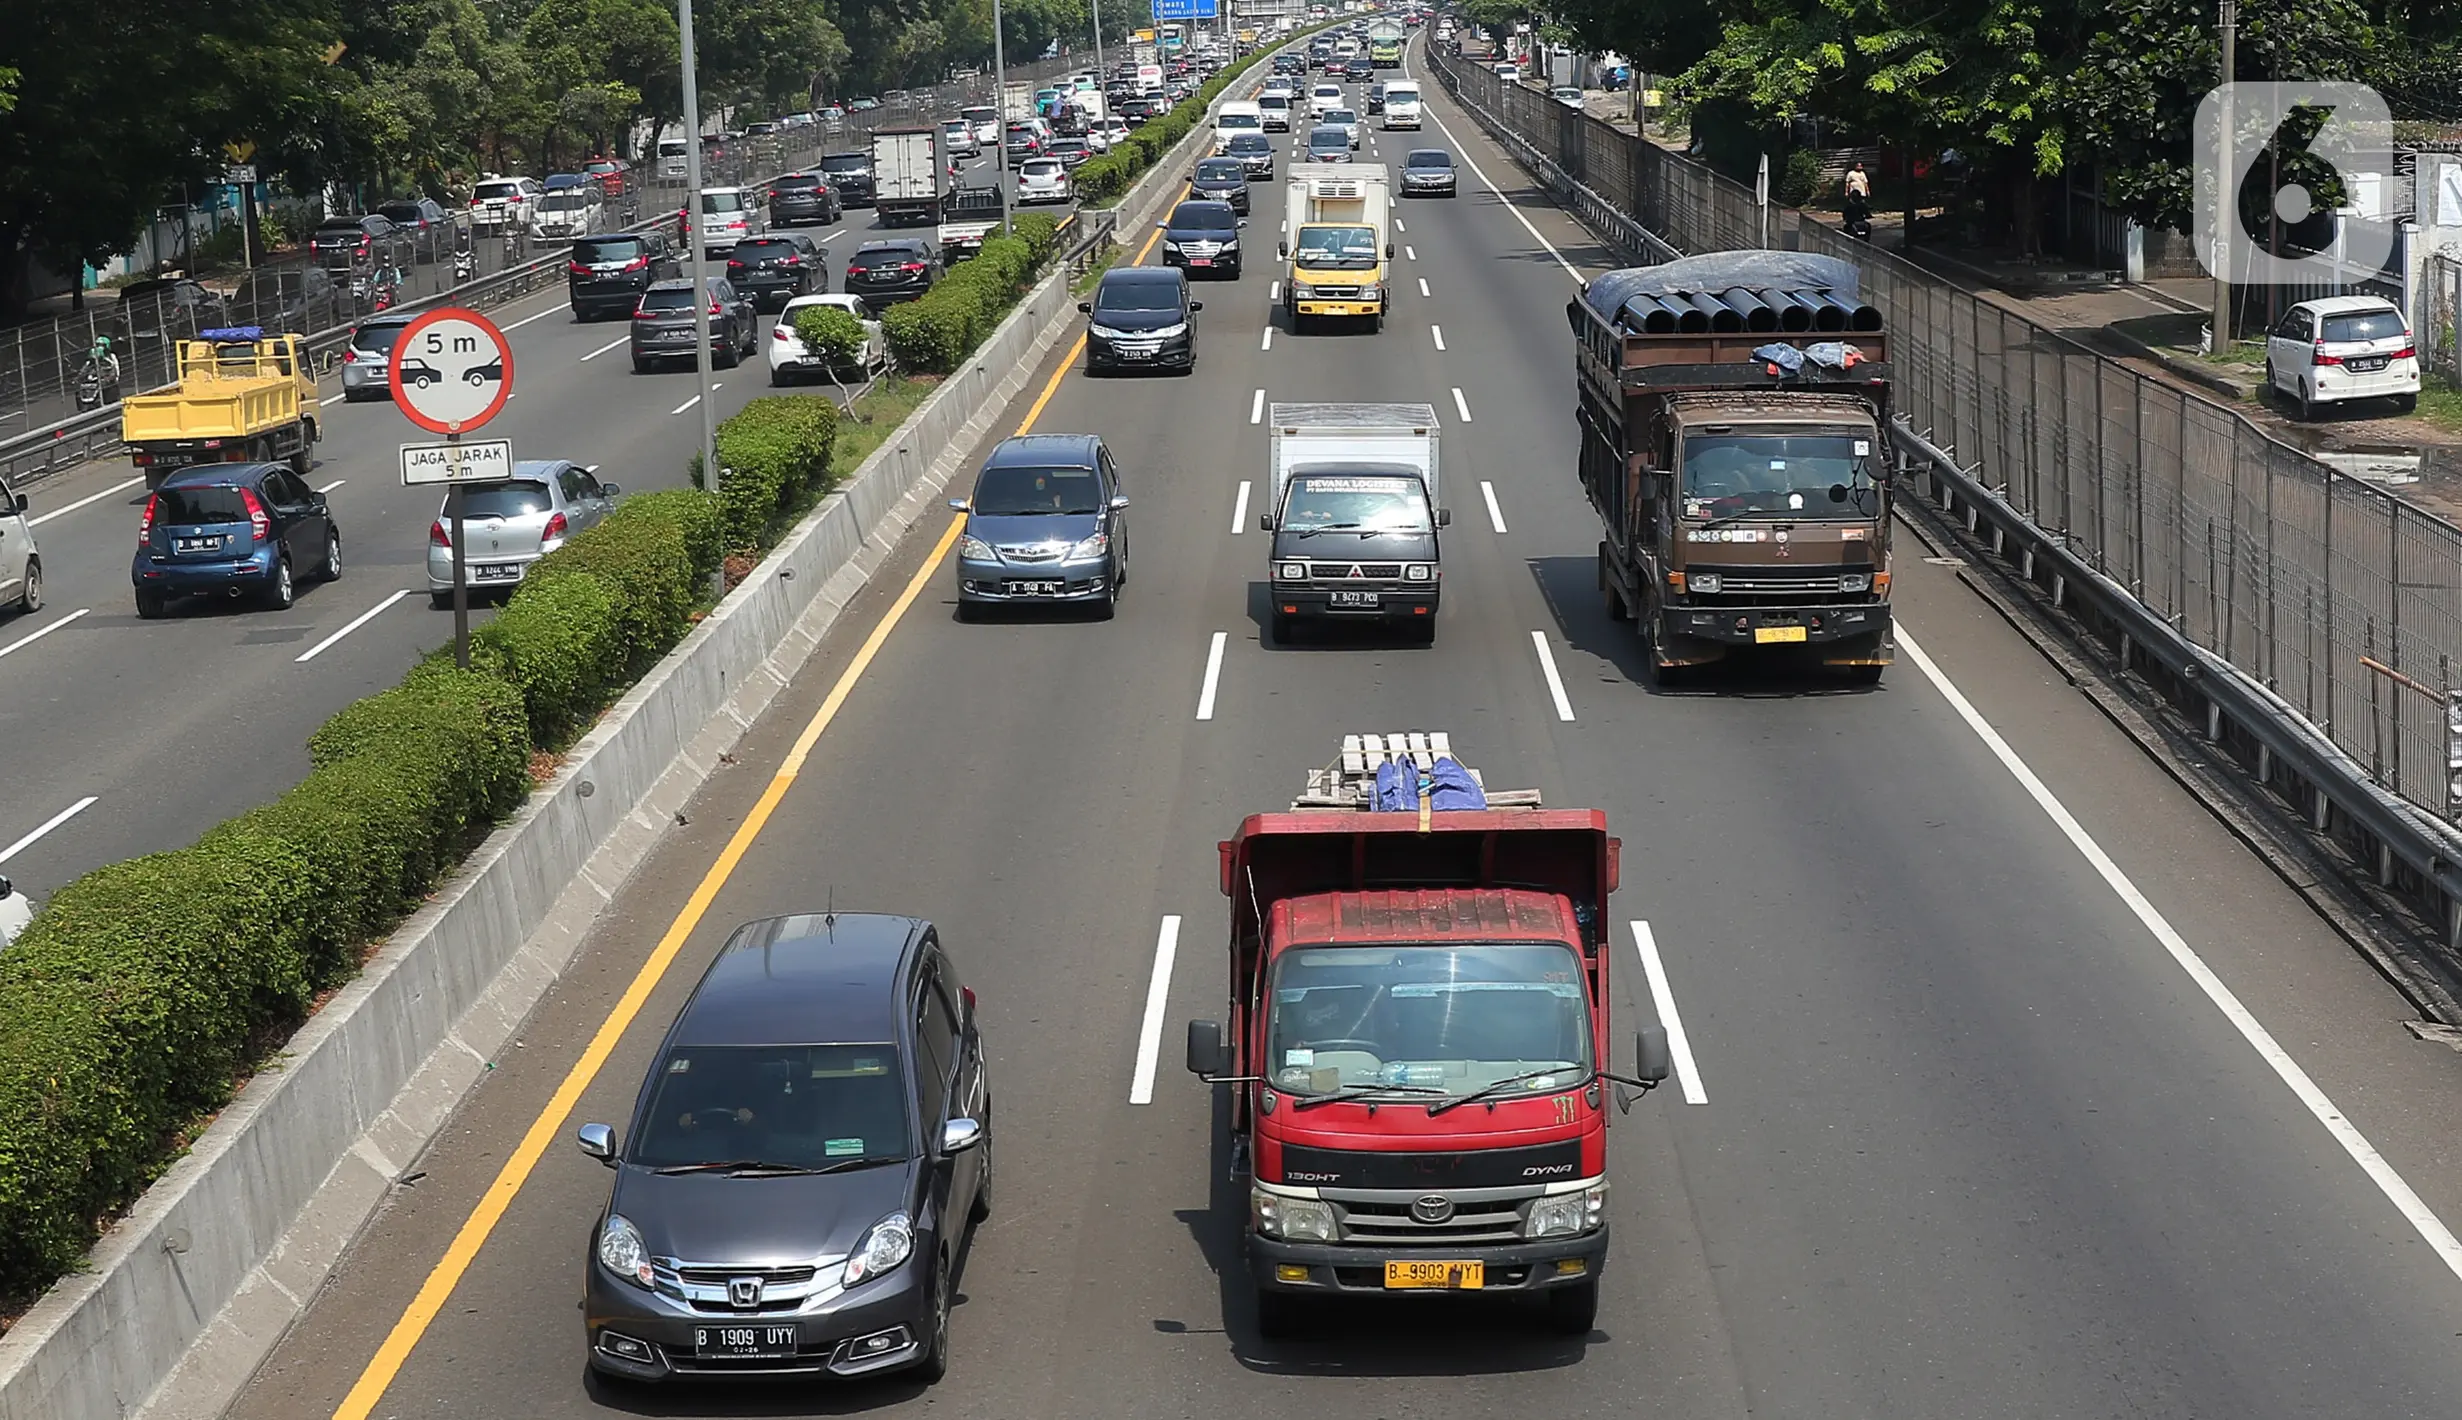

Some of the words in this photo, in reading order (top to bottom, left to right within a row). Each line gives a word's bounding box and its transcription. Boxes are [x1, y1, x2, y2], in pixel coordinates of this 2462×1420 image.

[427, 333, 443, 354] 5
[454, 336, 476, 353] m
[411, 452, 446, 466] JAGA
[454, 448, 503, 463] JARAK
[446, 465, 455, 477] 5
[461, 466, 473, 476] m
[1306, 479, 1350, 488] DEVANA
[1522, 1164, 1573, 1176] DYNA
[1287, 1171, 1341, 1182] 130HT
[698, 1329, 708, 1346] B
[720, 1329, 755, 1346] 1909
[767, 1327, 794, 1344] UYY
